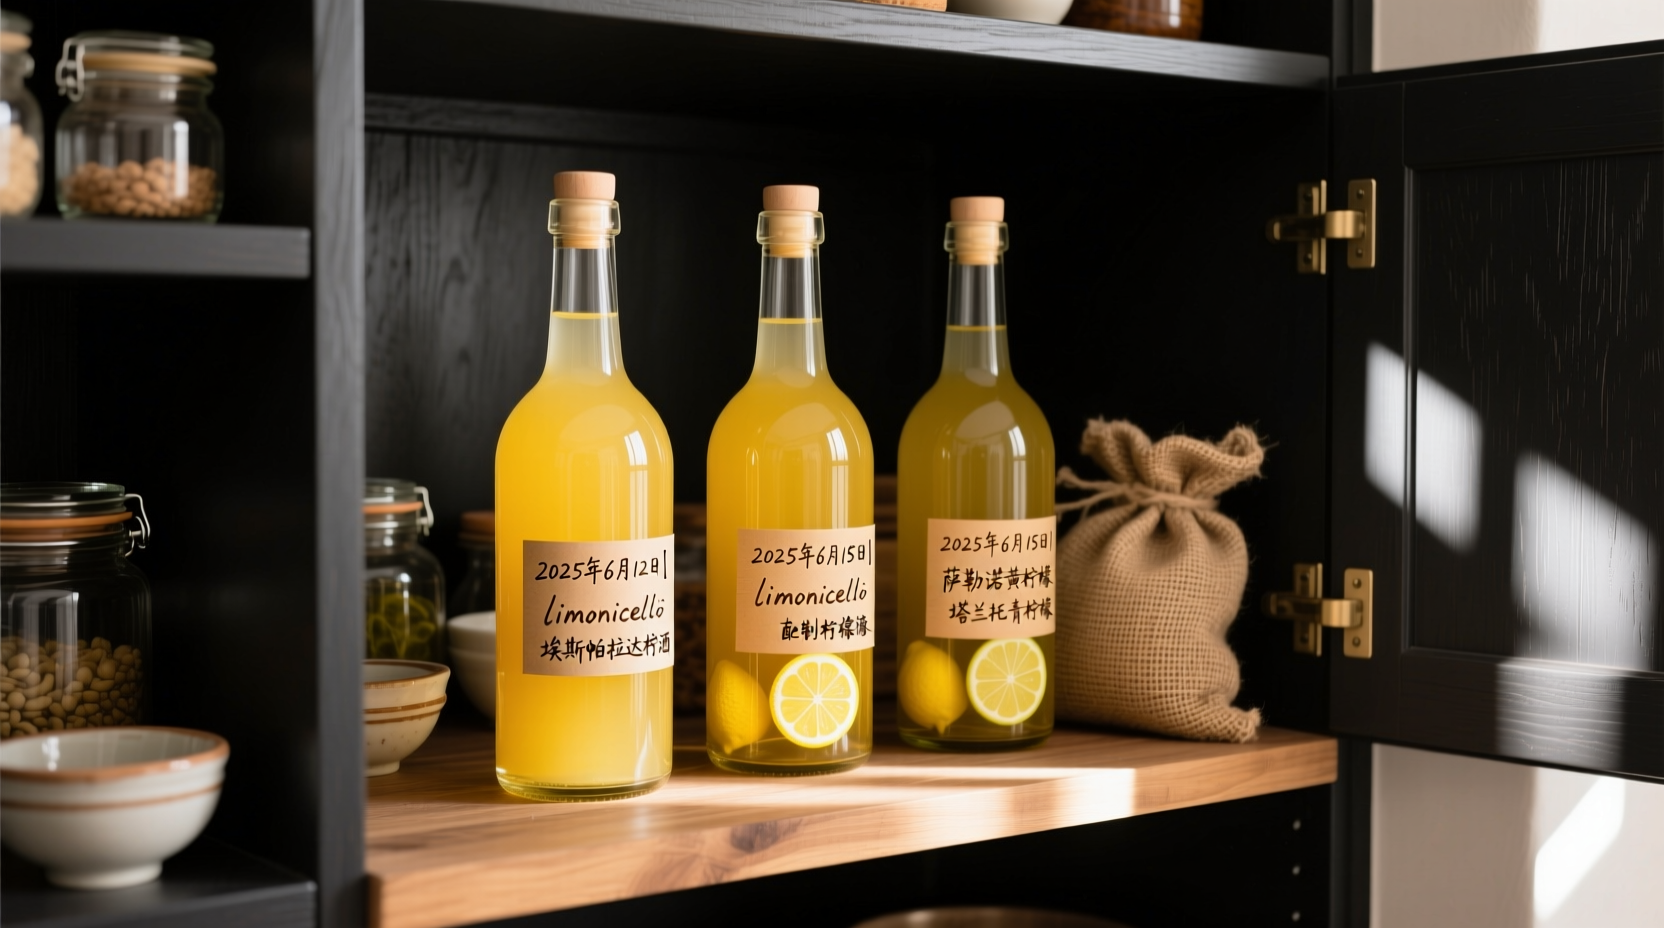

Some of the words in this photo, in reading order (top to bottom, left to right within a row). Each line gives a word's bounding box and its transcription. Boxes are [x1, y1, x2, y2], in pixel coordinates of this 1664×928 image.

[948, 596, 1054, 625] 塔兰托青柠檬
